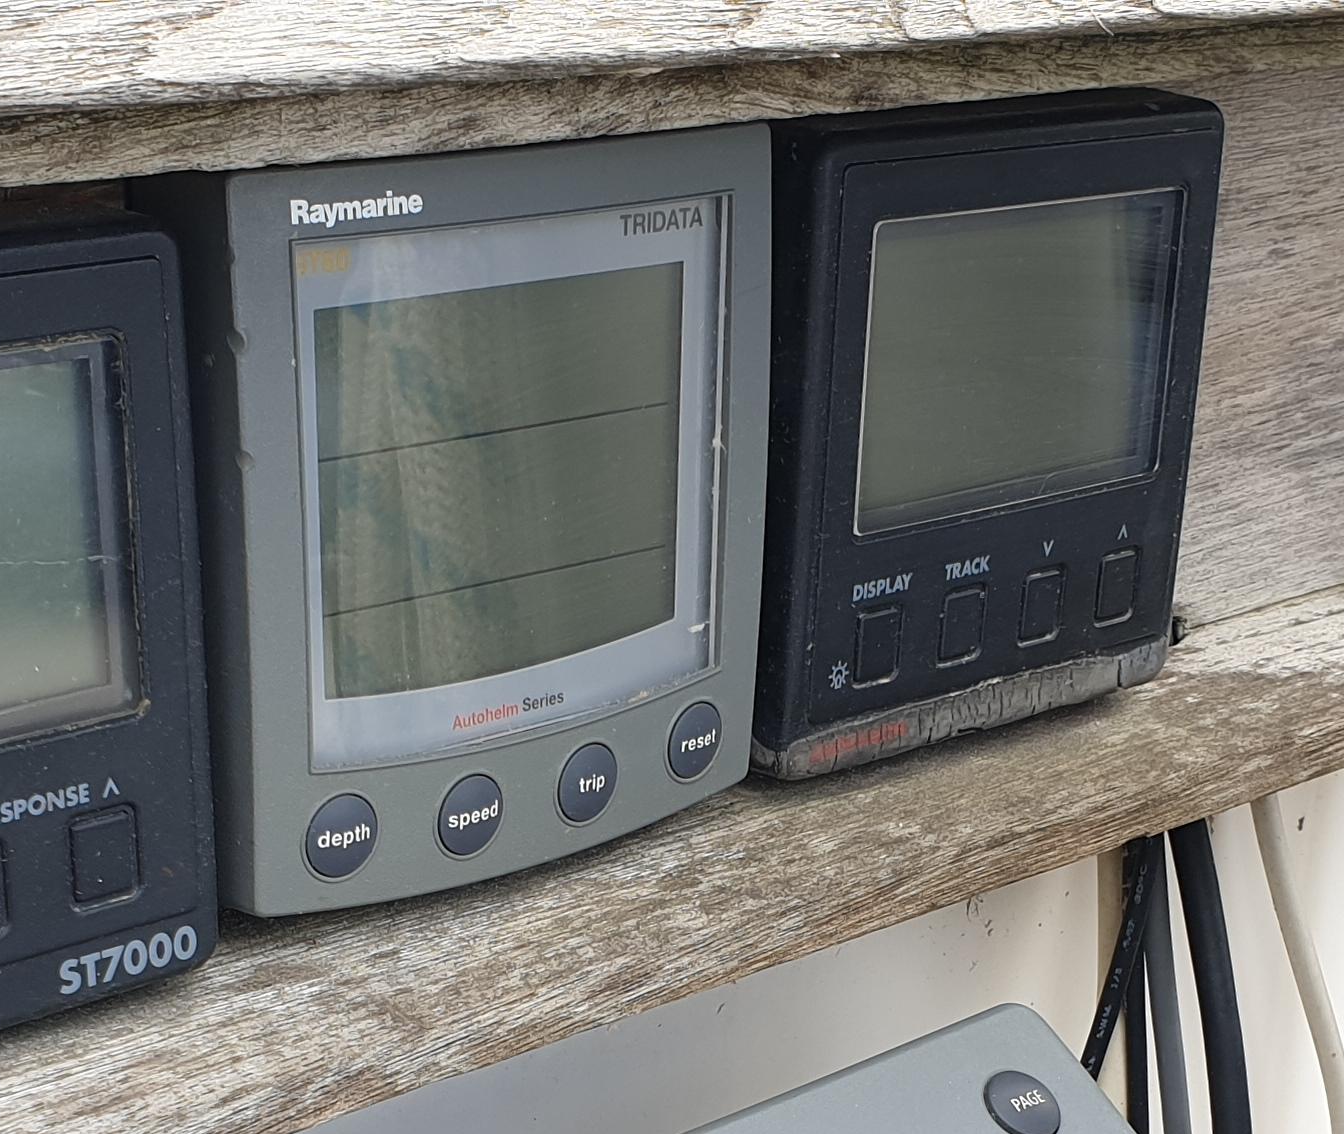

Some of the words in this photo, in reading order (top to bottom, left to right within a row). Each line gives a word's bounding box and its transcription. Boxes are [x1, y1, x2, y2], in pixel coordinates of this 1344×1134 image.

[290, 190, 424, 229] Raymarine
[620, 206, 704, 238] TRIDATA
[945, 555, 991, 582] TRACK
[852, 573, 913, 601] DISPLAY
[452, 701, 519, 731] Autohelm
[522, 689, 565, 713] Series
[680, 729, 717, 753] reset
[578, 773, 606, 796] trip
[448, 799, 500, 831] speed
[317, 823, 372, 853] depth
[58, 925, 198, 996] ST7000
[1010, 1089, 1046, 1113] PAGE
